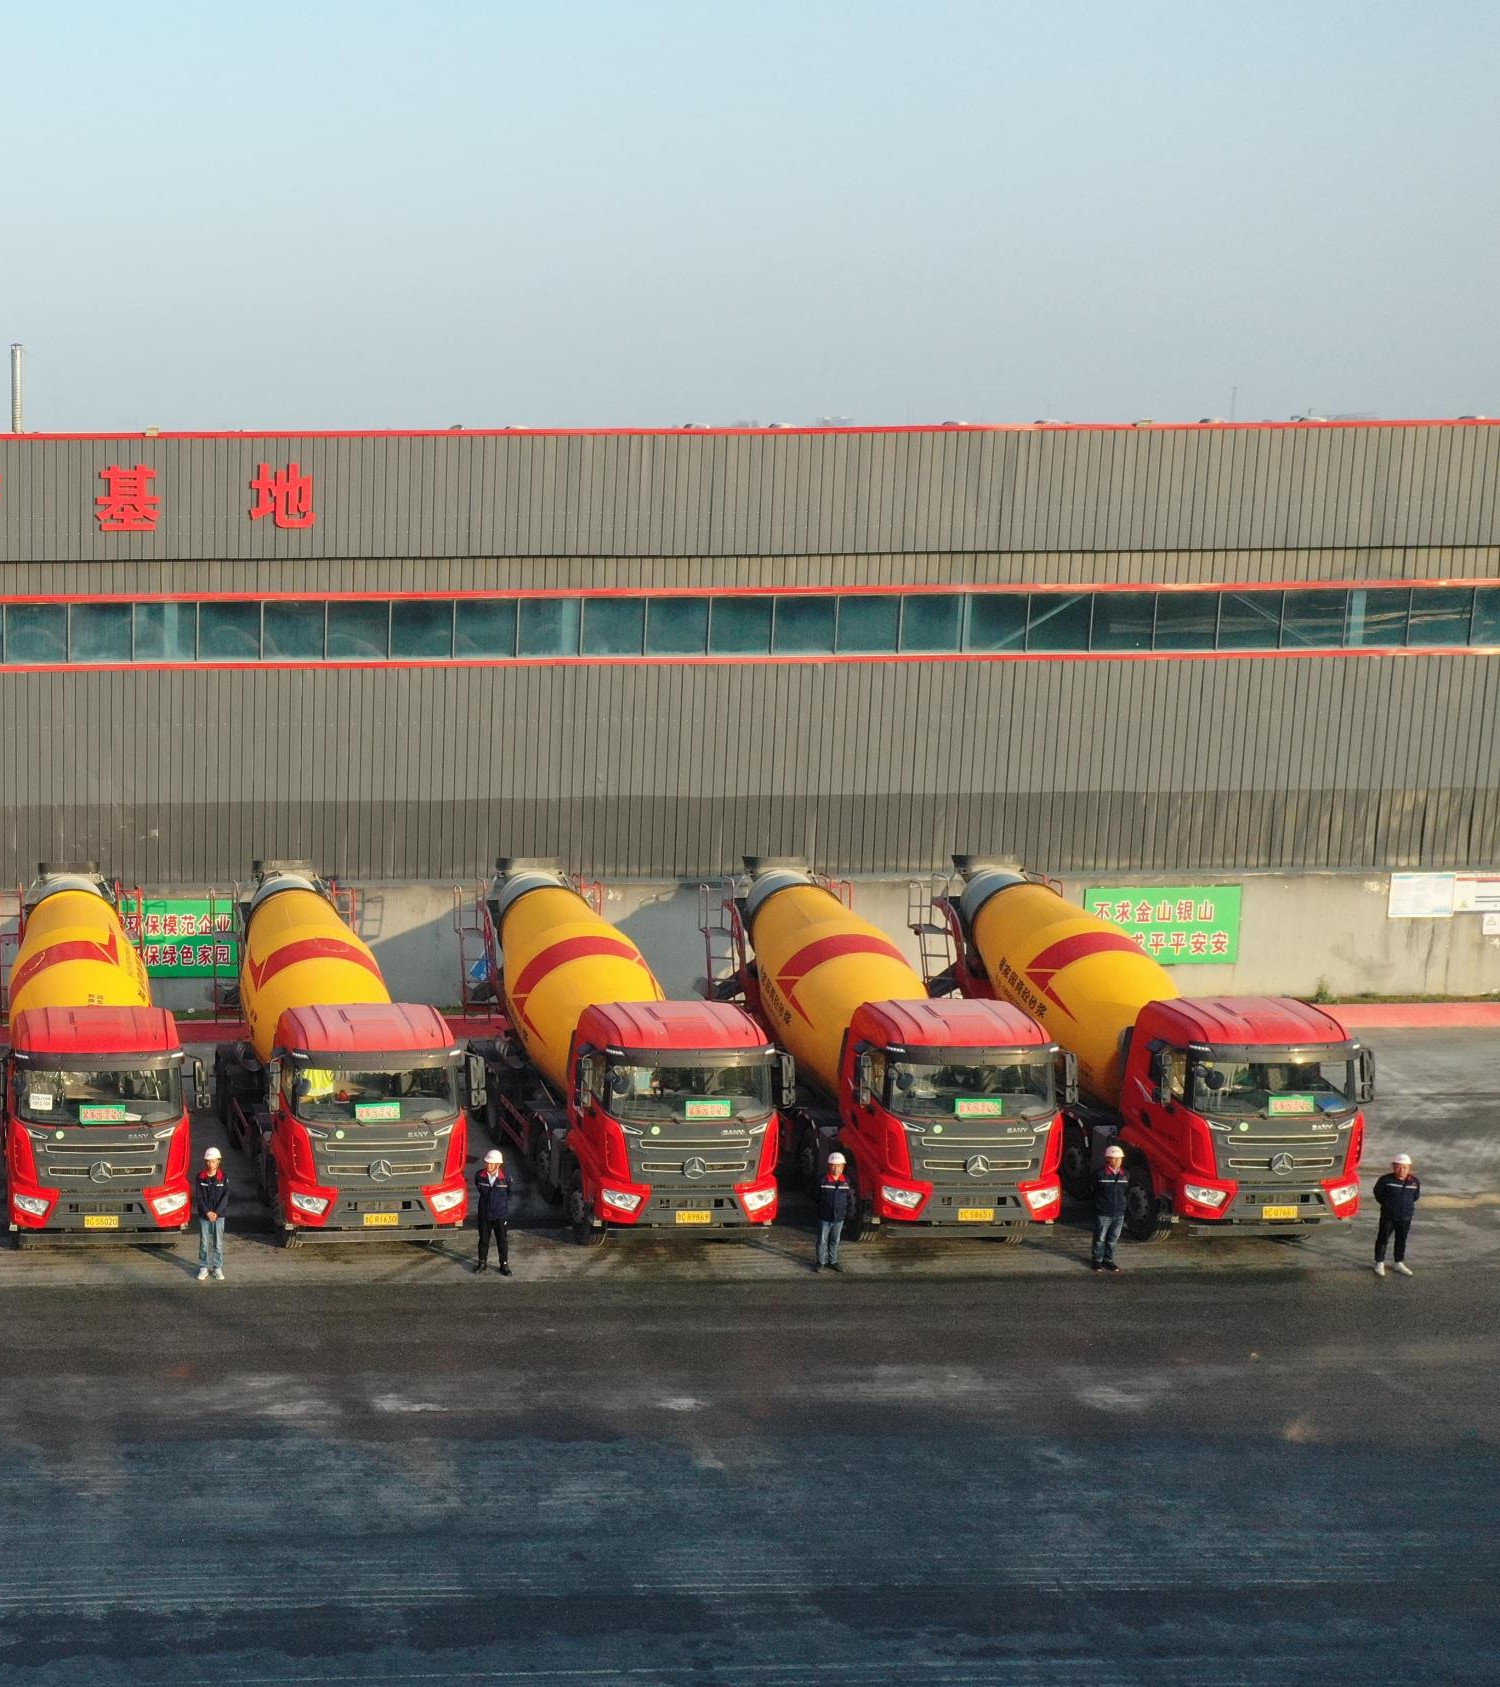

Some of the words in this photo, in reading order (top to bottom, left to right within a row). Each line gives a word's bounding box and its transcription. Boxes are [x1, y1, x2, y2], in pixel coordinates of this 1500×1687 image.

[1094, 900, 1215, 923] 不求金山银山
[118, 913, 232, 936] 环保模范企业
